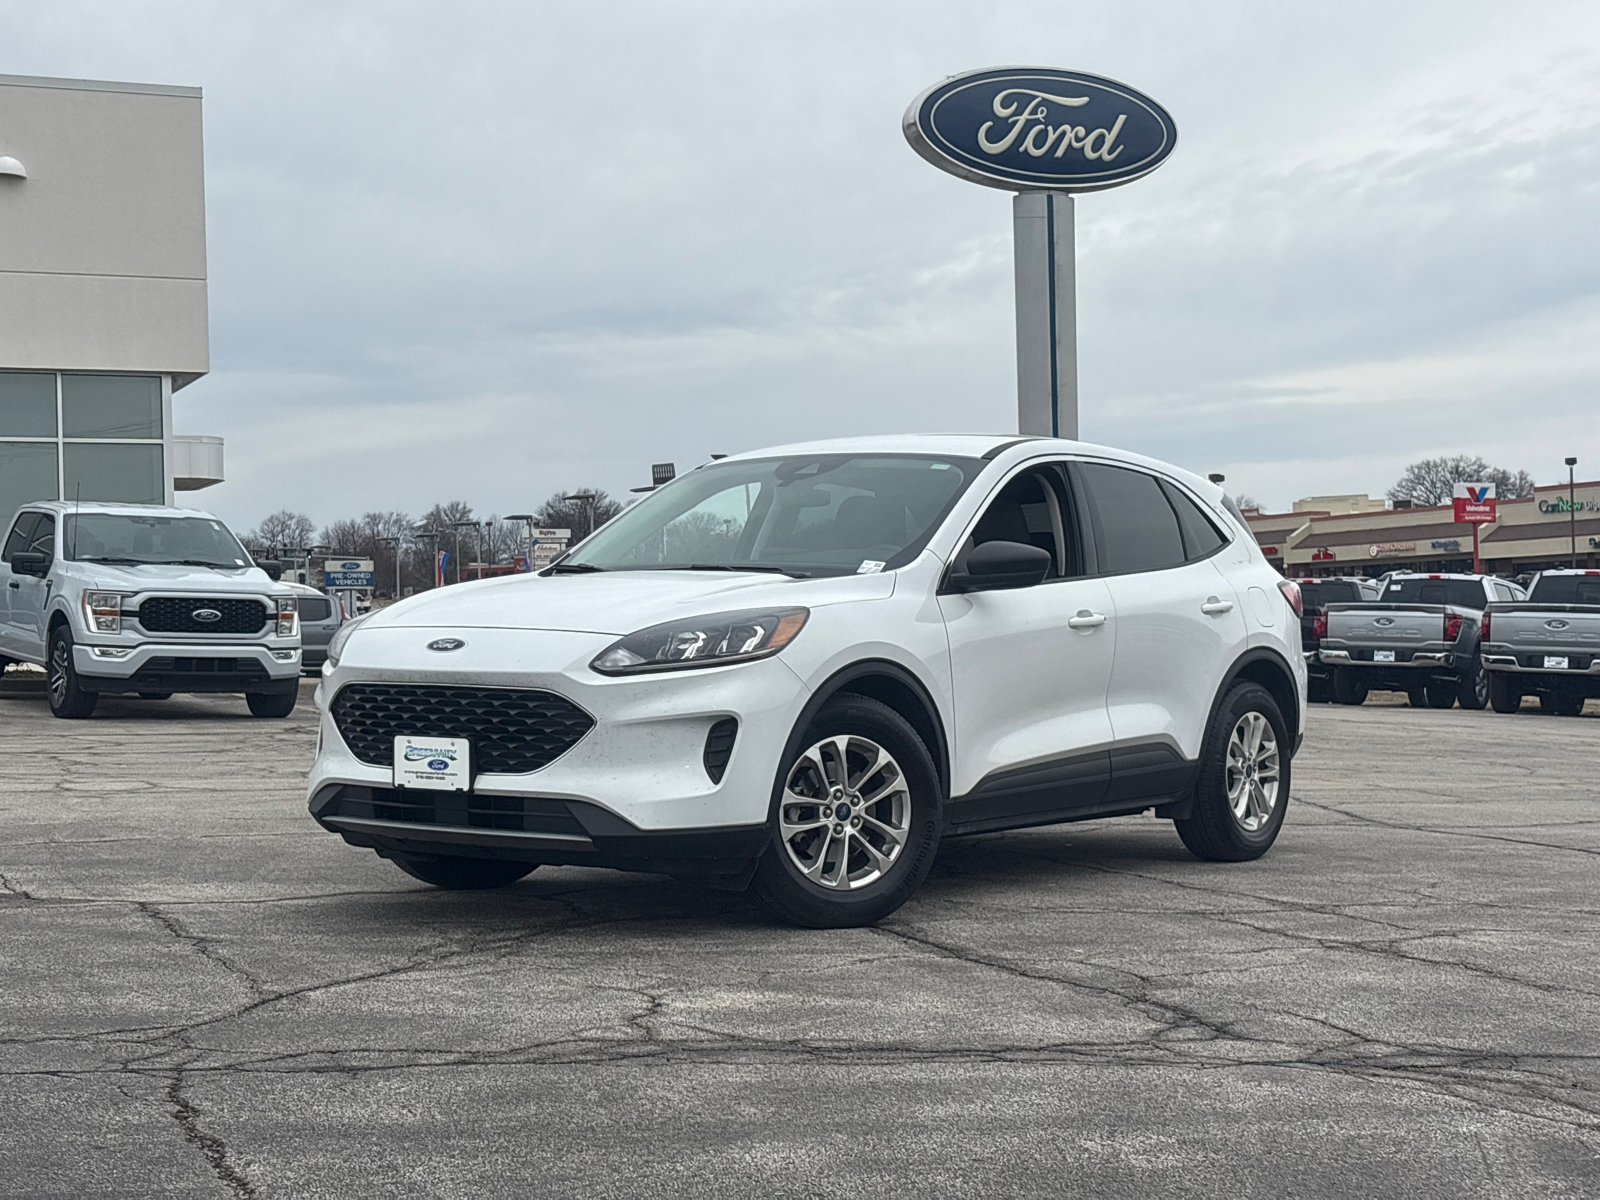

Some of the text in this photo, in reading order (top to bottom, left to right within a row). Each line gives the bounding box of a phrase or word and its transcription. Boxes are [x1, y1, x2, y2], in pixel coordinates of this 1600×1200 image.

[977, 88, 1128, 163] Ford
[433, 639, 458, 649] Ford
[902, 820, 936, 887] Continental
